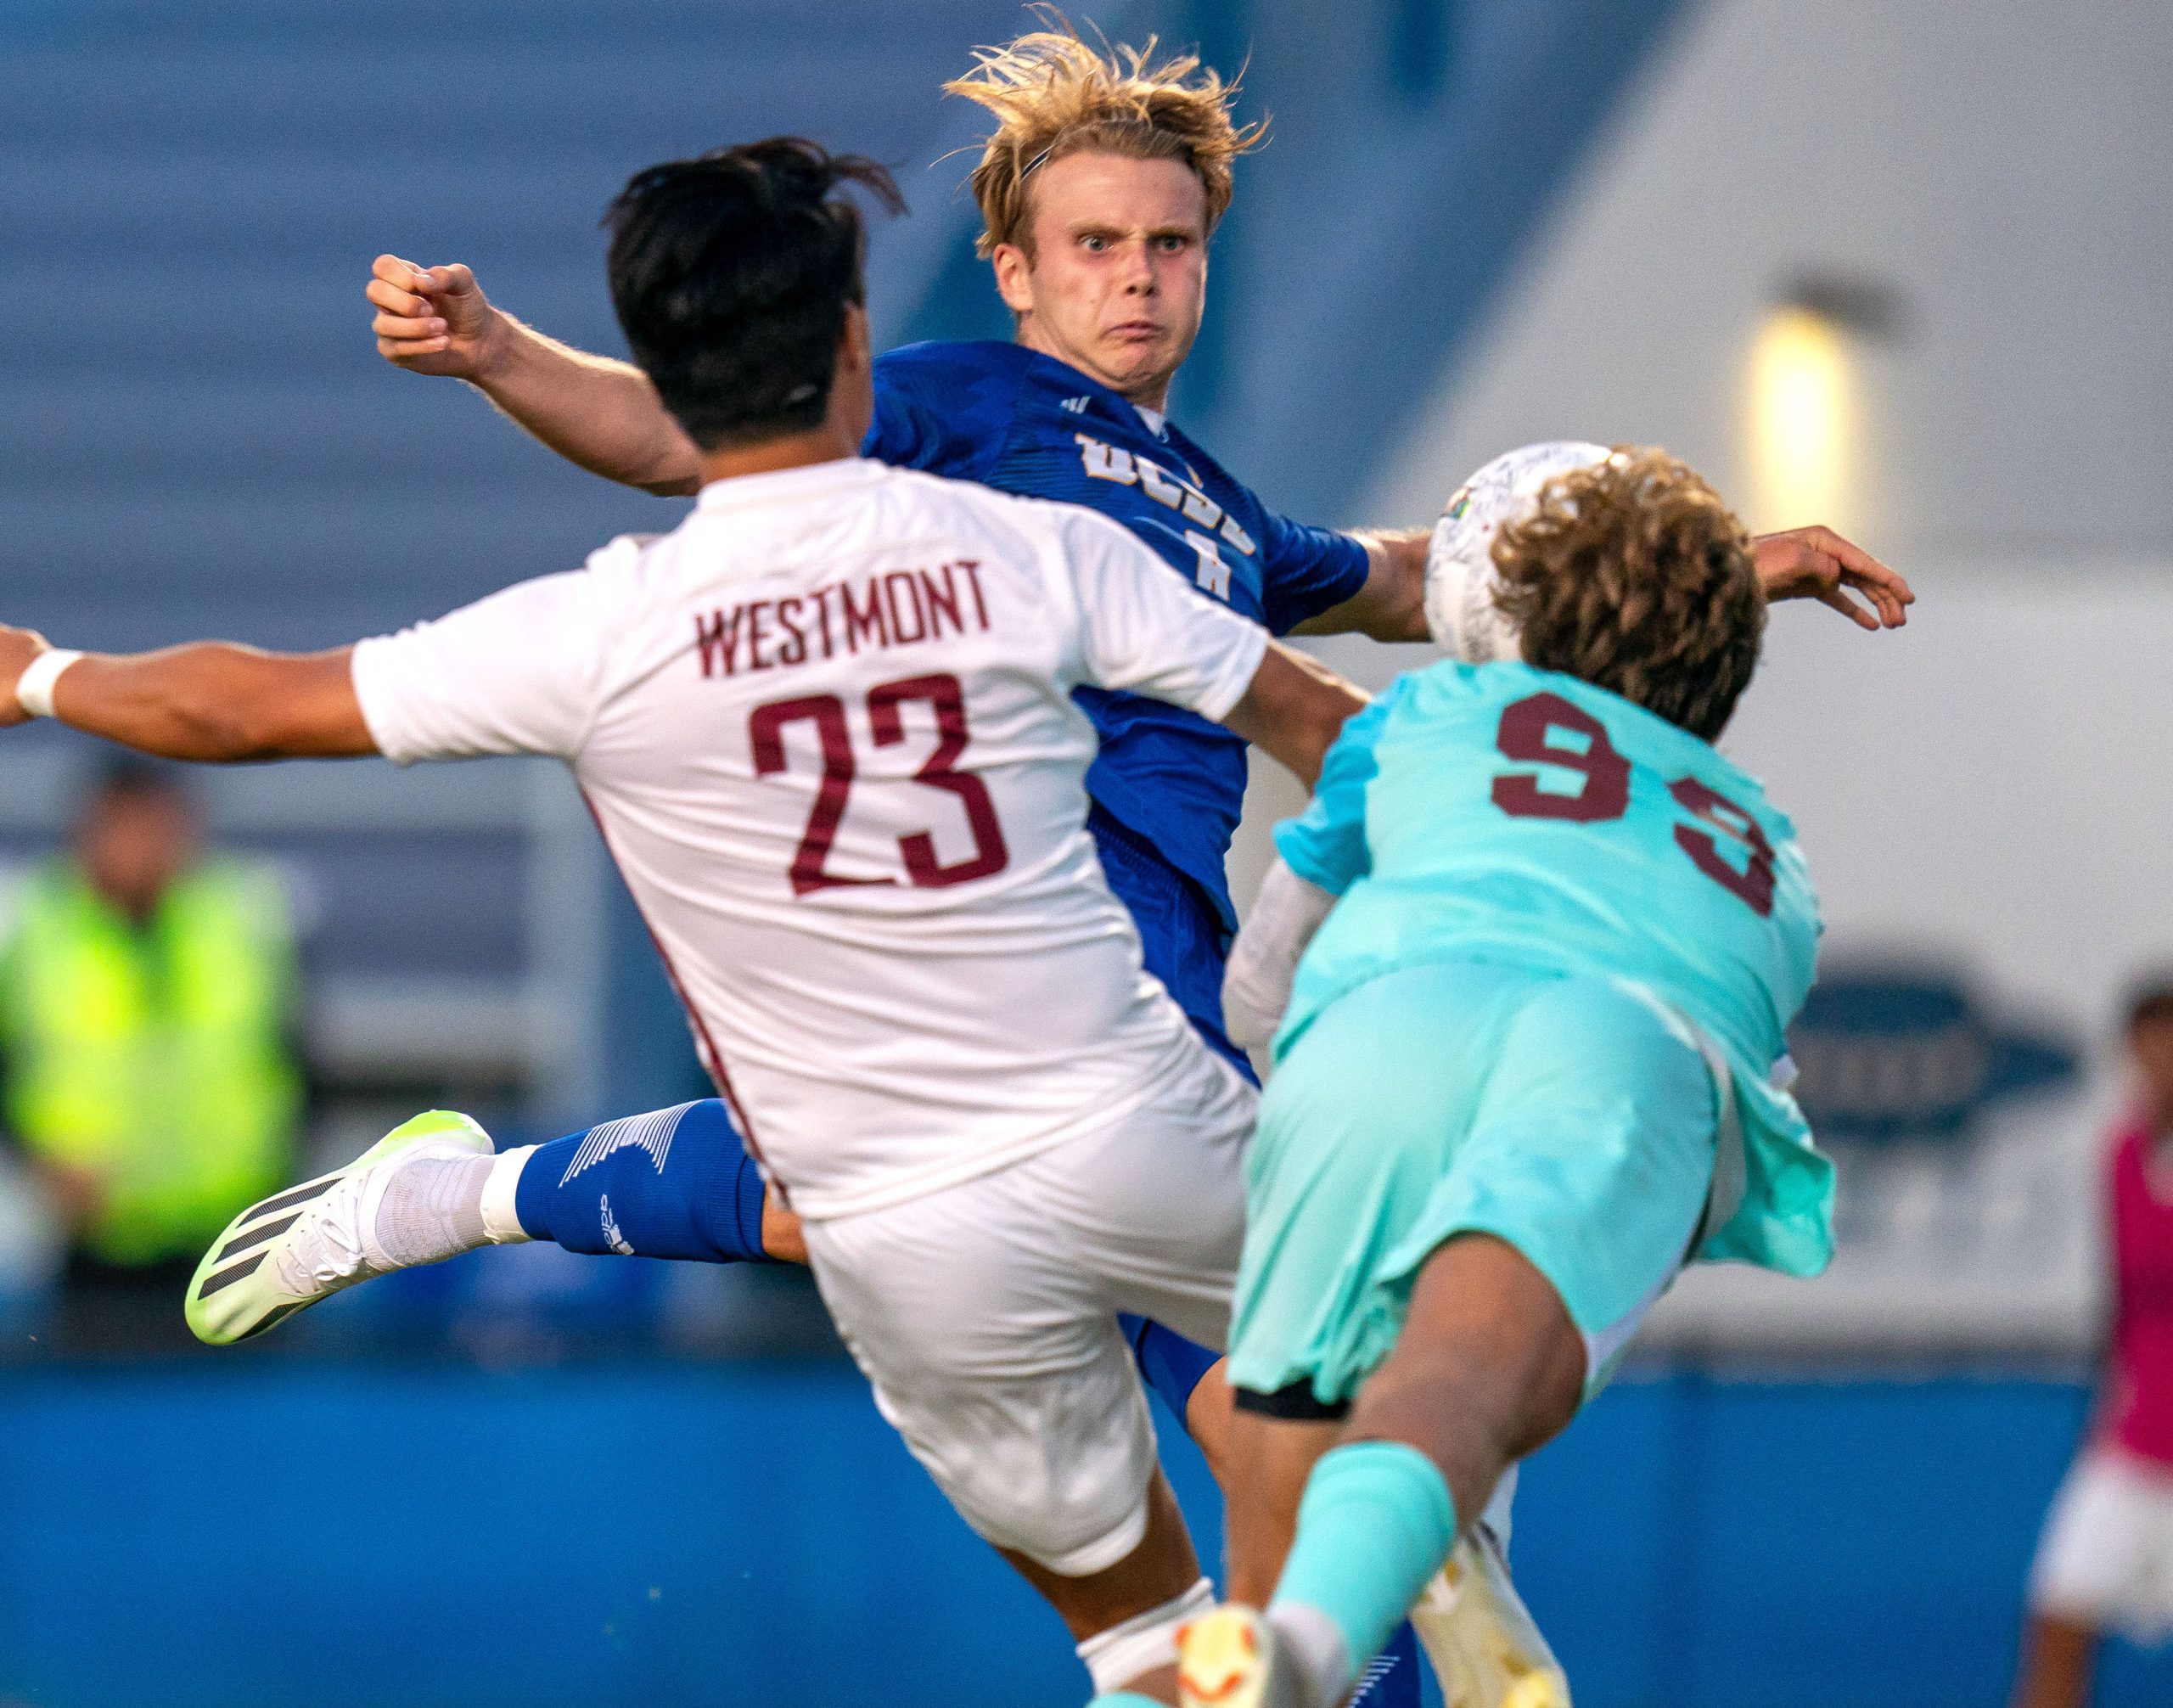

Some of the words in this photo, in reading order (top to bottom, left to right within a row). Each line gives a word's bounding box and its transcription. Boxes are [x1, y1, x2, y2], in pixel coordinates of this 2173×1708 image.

[694, 559, 991, 680] WESTMONT
[749, 671, 1010, 900] 23
[600, 1193, 624, 1255] adid
